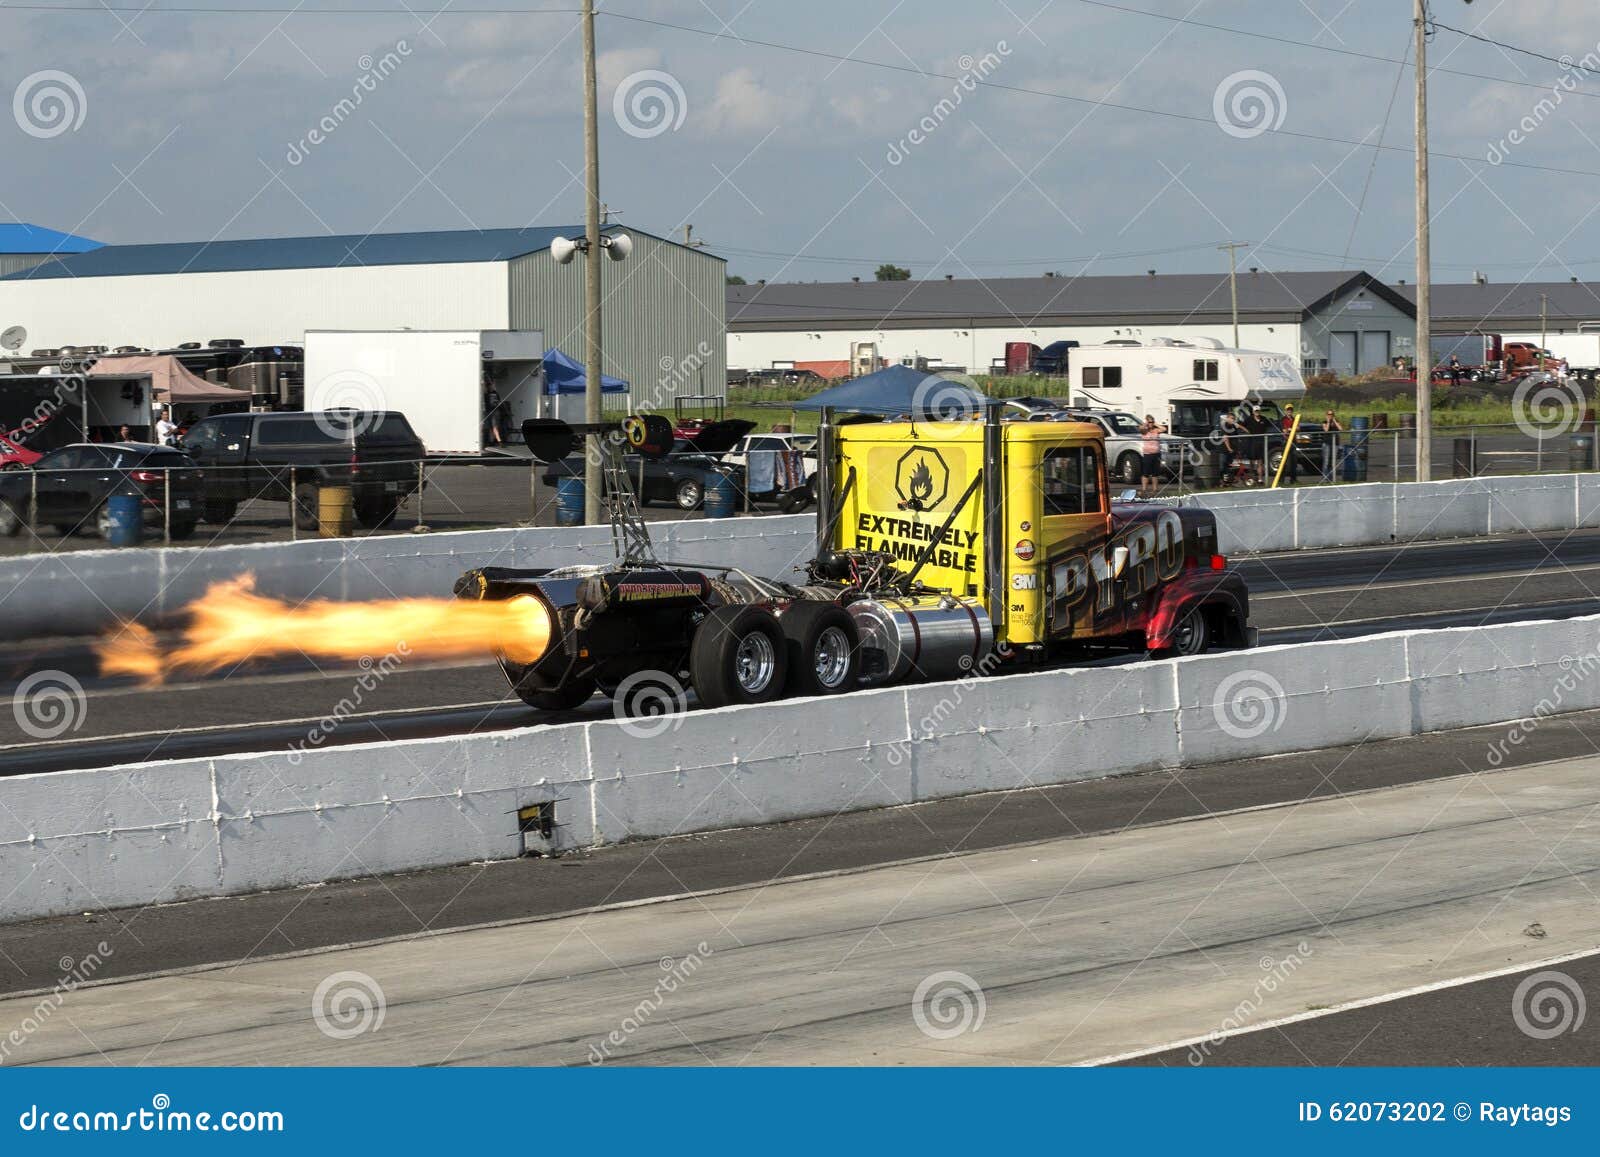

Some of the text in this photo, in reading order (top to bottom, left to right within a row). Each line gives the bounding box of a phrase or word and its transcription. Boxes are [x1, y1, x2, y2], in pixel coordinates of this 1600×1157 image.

[858, 513, 979, 549] EXTREMELY
[855, 534, 977, 573] FLAMMABLE
[1051, 510, 1184, 632] PYRO
[1011, 574, 1037, 590] 3M
[1011, 604, 1025, 612] 3M
